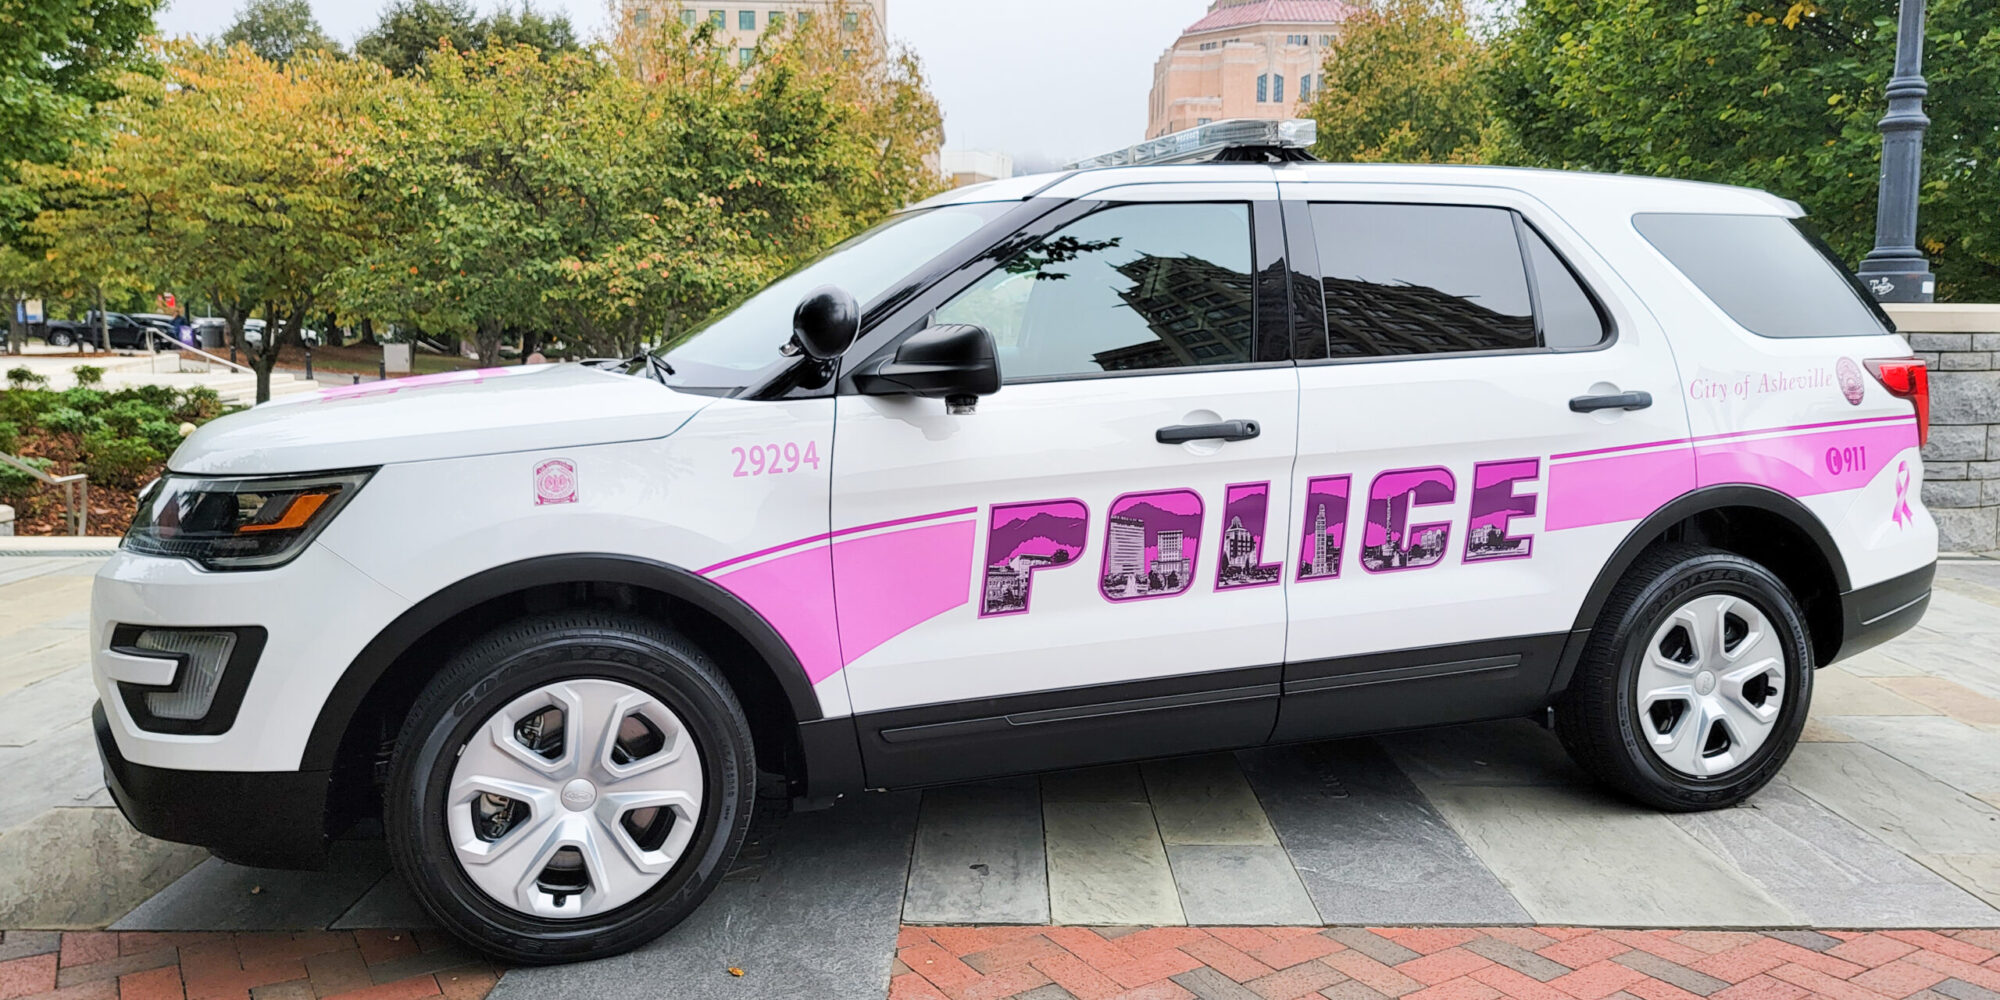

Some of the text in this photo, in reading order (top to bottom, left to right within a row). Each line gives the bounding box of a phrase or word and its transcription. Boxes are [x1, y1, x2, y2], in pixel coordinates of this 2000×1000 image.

[1690, 378, 1727, 402] City
[1734, 374, 1751, 400] of
[1757, 368, 1833, 393] Asheville
[731, 440, 820, 477] 29294
[1843, 446, 1866, 472] 911
[978, 456, 1541, 619] POLICE
